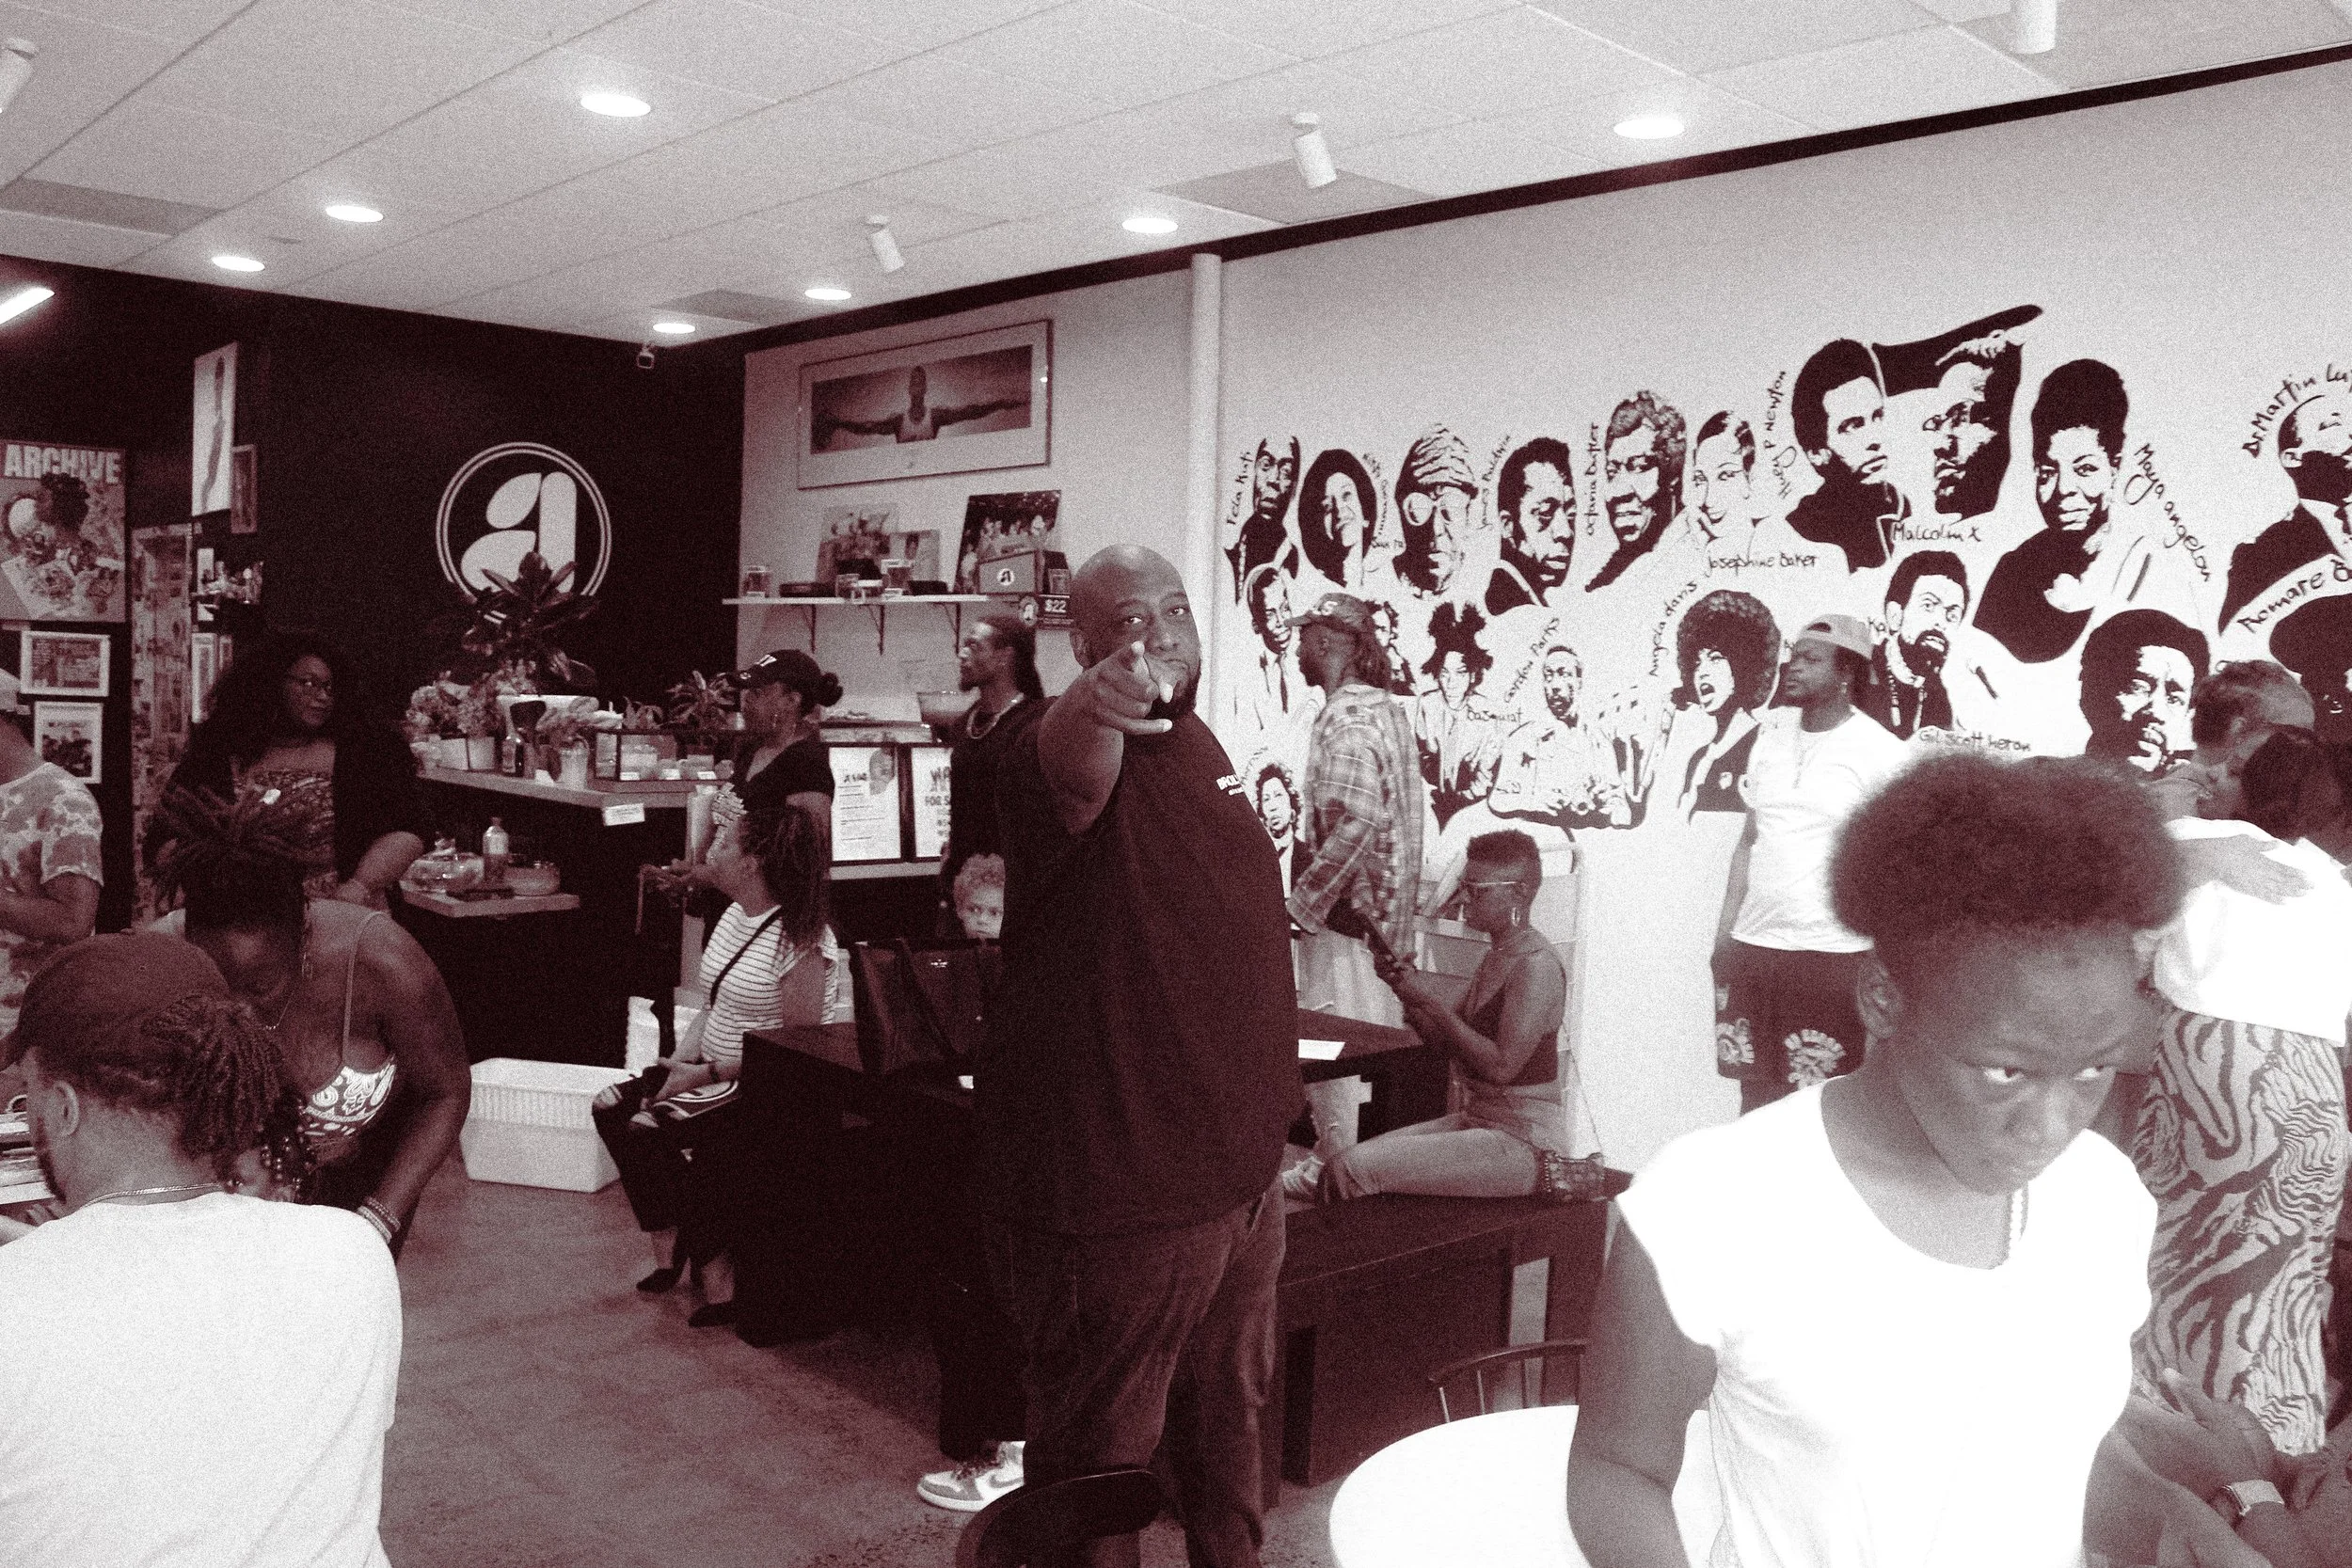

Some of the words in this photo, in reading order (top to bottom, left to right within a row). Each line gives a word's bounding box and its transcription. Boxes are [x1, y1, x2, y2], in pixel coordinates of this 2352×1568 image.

[2326, 363, 2352, 393] Lu
[4, 443, 121, 483] ARCHIVE
[2123, 443, 2165, 506] Maya
[1894, 523, 1963, 543] Malcolm
